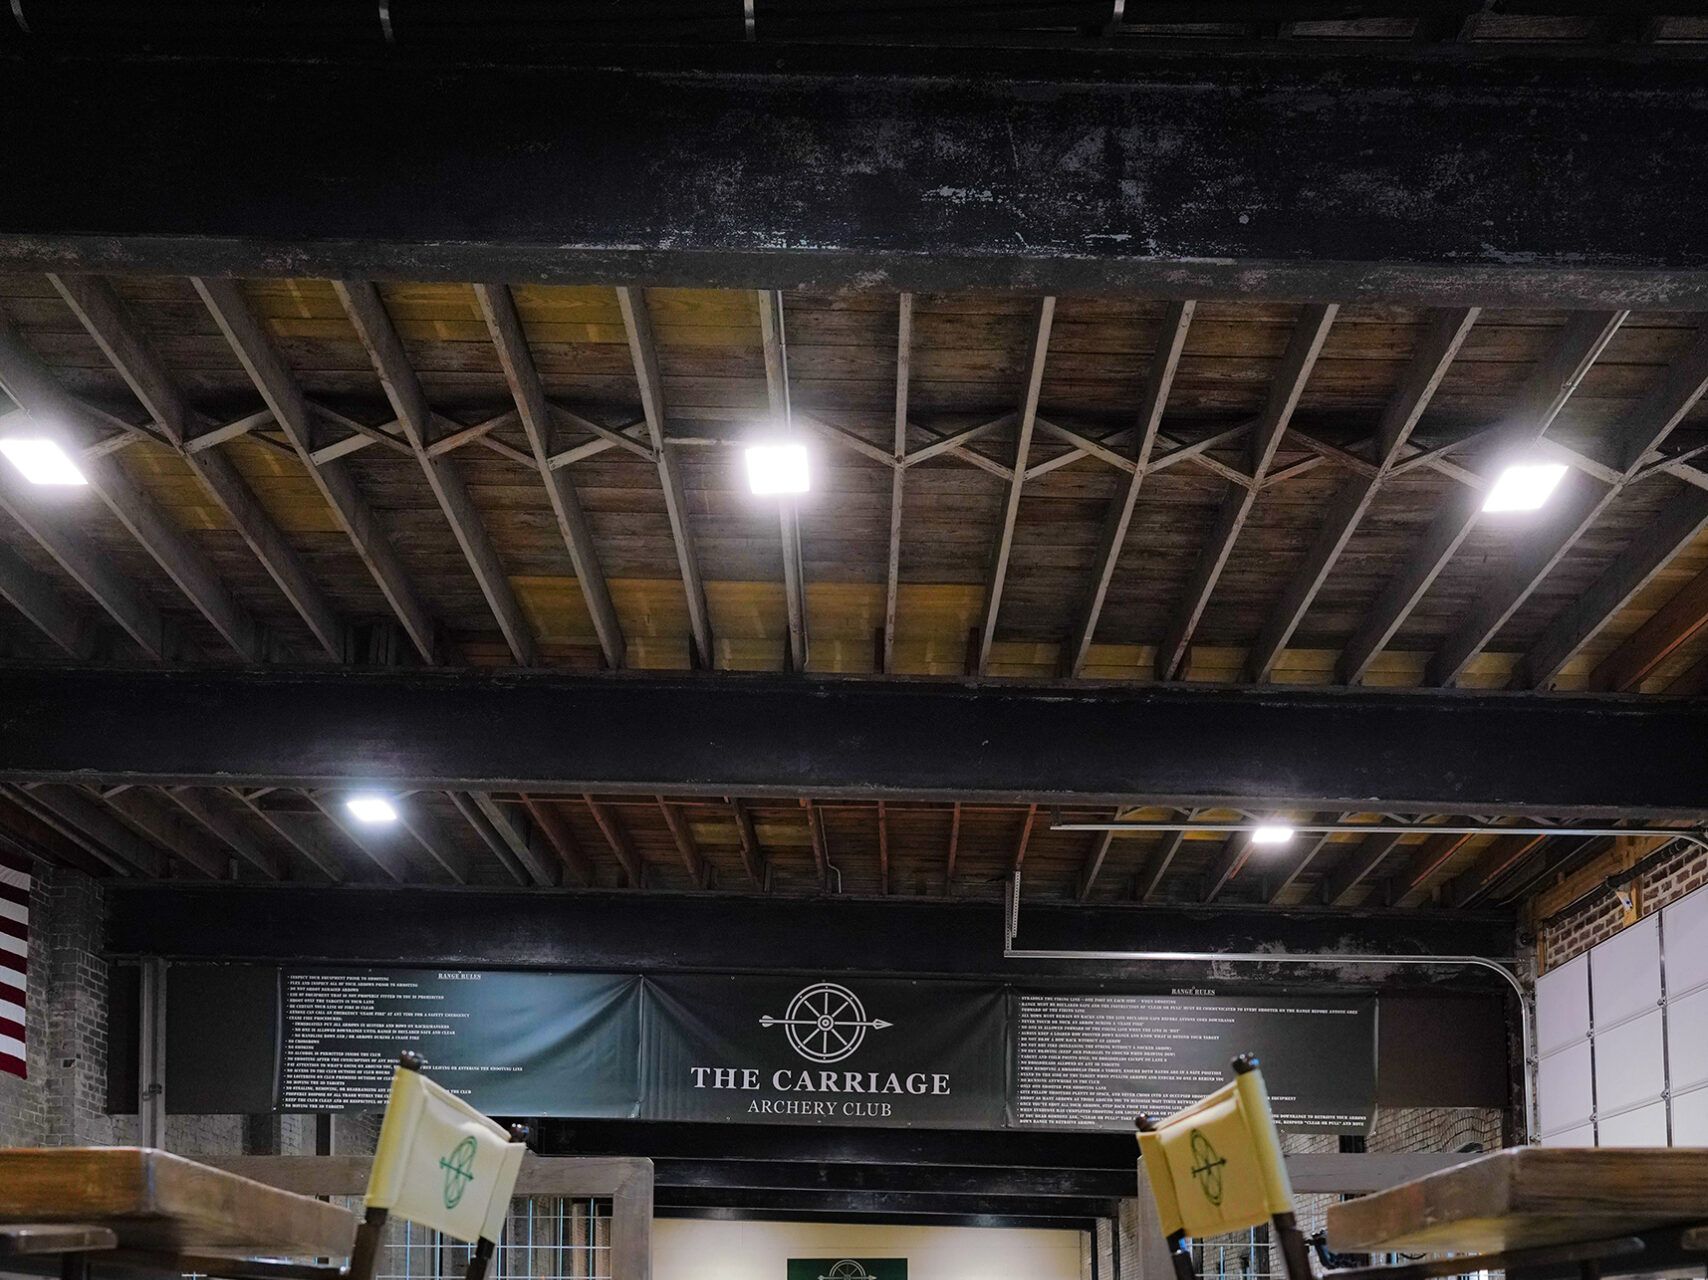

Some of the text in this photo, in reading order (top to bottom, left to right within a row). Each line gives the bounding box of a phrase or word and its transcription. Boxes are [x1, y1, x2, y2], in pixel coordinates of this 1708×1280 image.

[691, 1066, 950, 1094] THE CARRIAGE
[748, 1100, 892, 1116] ARCHERY CLUB
